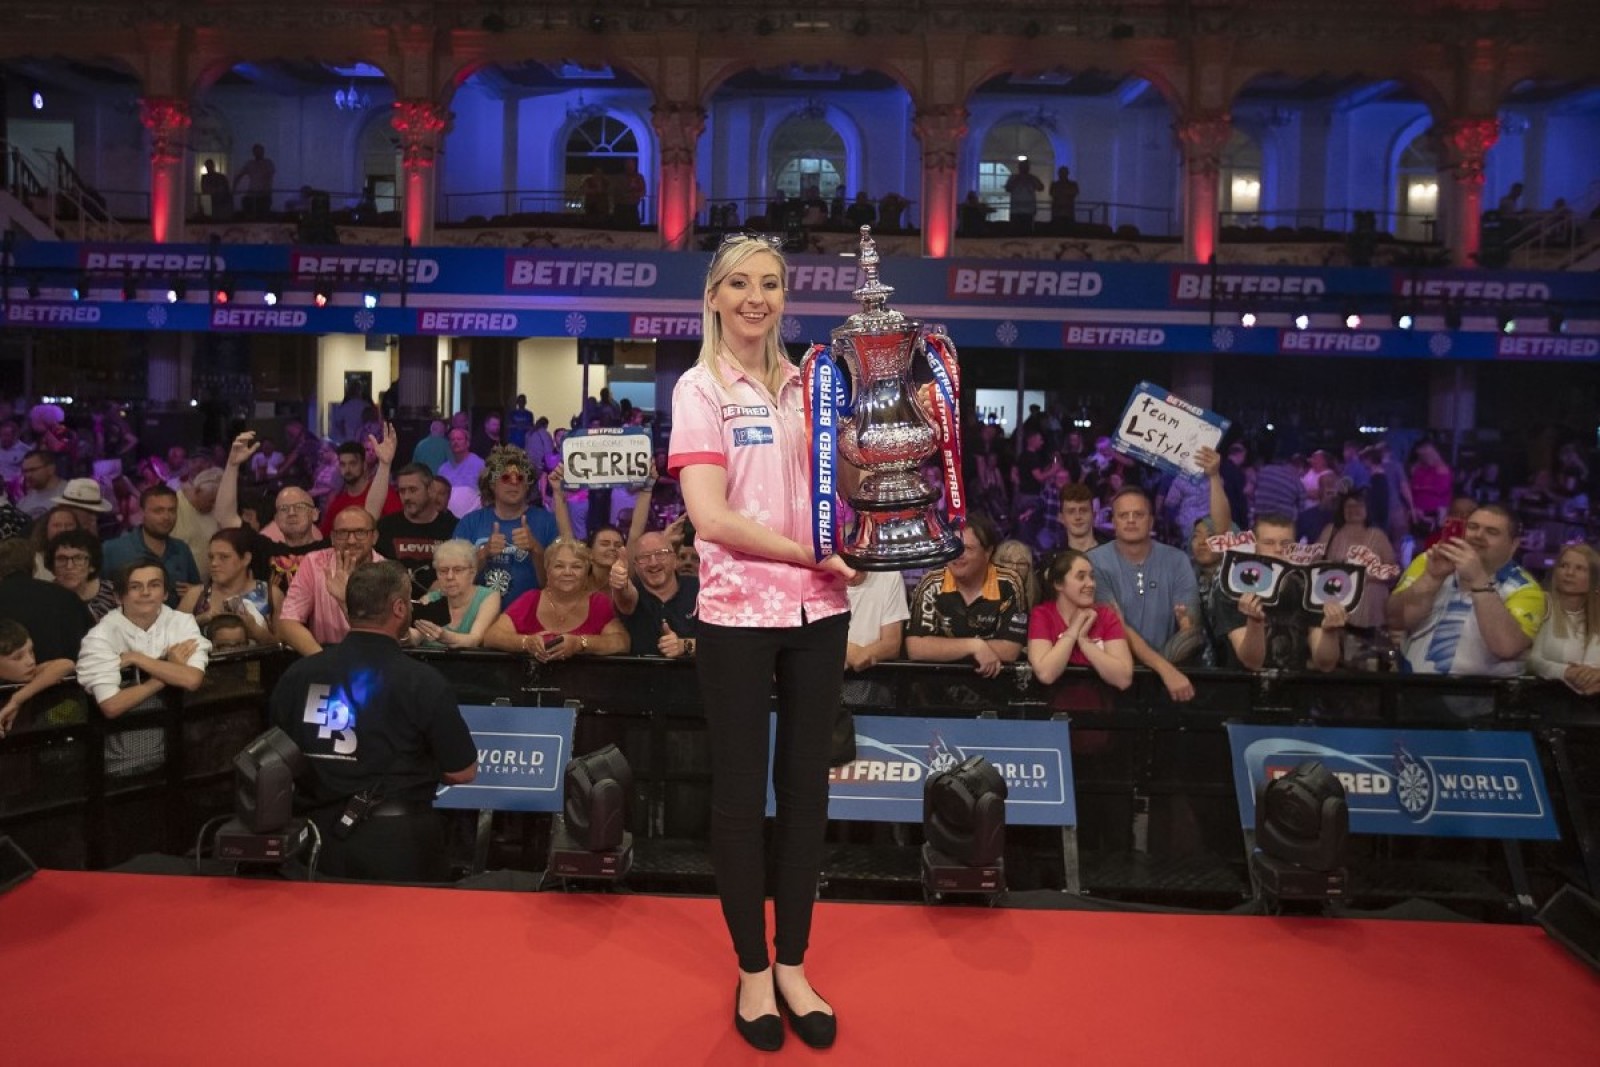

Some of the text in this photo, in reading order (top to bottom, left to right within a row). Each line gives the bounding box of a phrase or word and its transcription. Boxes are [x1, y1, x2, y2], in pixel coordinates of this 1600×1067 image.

[511, 261, 657, 287] BETFRED
[784, 266, 867, 291] TFRE
[953, 269, 1102, 297] BETFRED
[8, 304, 101, 323] BETFRED
[213, 309, 308, 328] BETFRED
[422, 312, 518, 331] BETFRED
[633, 316, 701, 335] BETFR
[1066, 326, 1165, 345] BETFRED
[1281, 332, 1381, 351] BETFRED
[1500, 336, 1599, 356] BETFRED
[819, 364, 832, 428] BETFRED
[567, 451, 649, 480] GIRLS
[819, 431, 832, 495] BETFRED
[943, 449, 961, 509] BETFRED
[477, 765, 545, 775] ATCHPLAY
[829, 760, 921, 782] TFRED
[991, 763, 1046, 780] RLD
[1439, 774, 1519, 791] WORLD
[1439, 791, 1524, 801] MATCHPLAY
